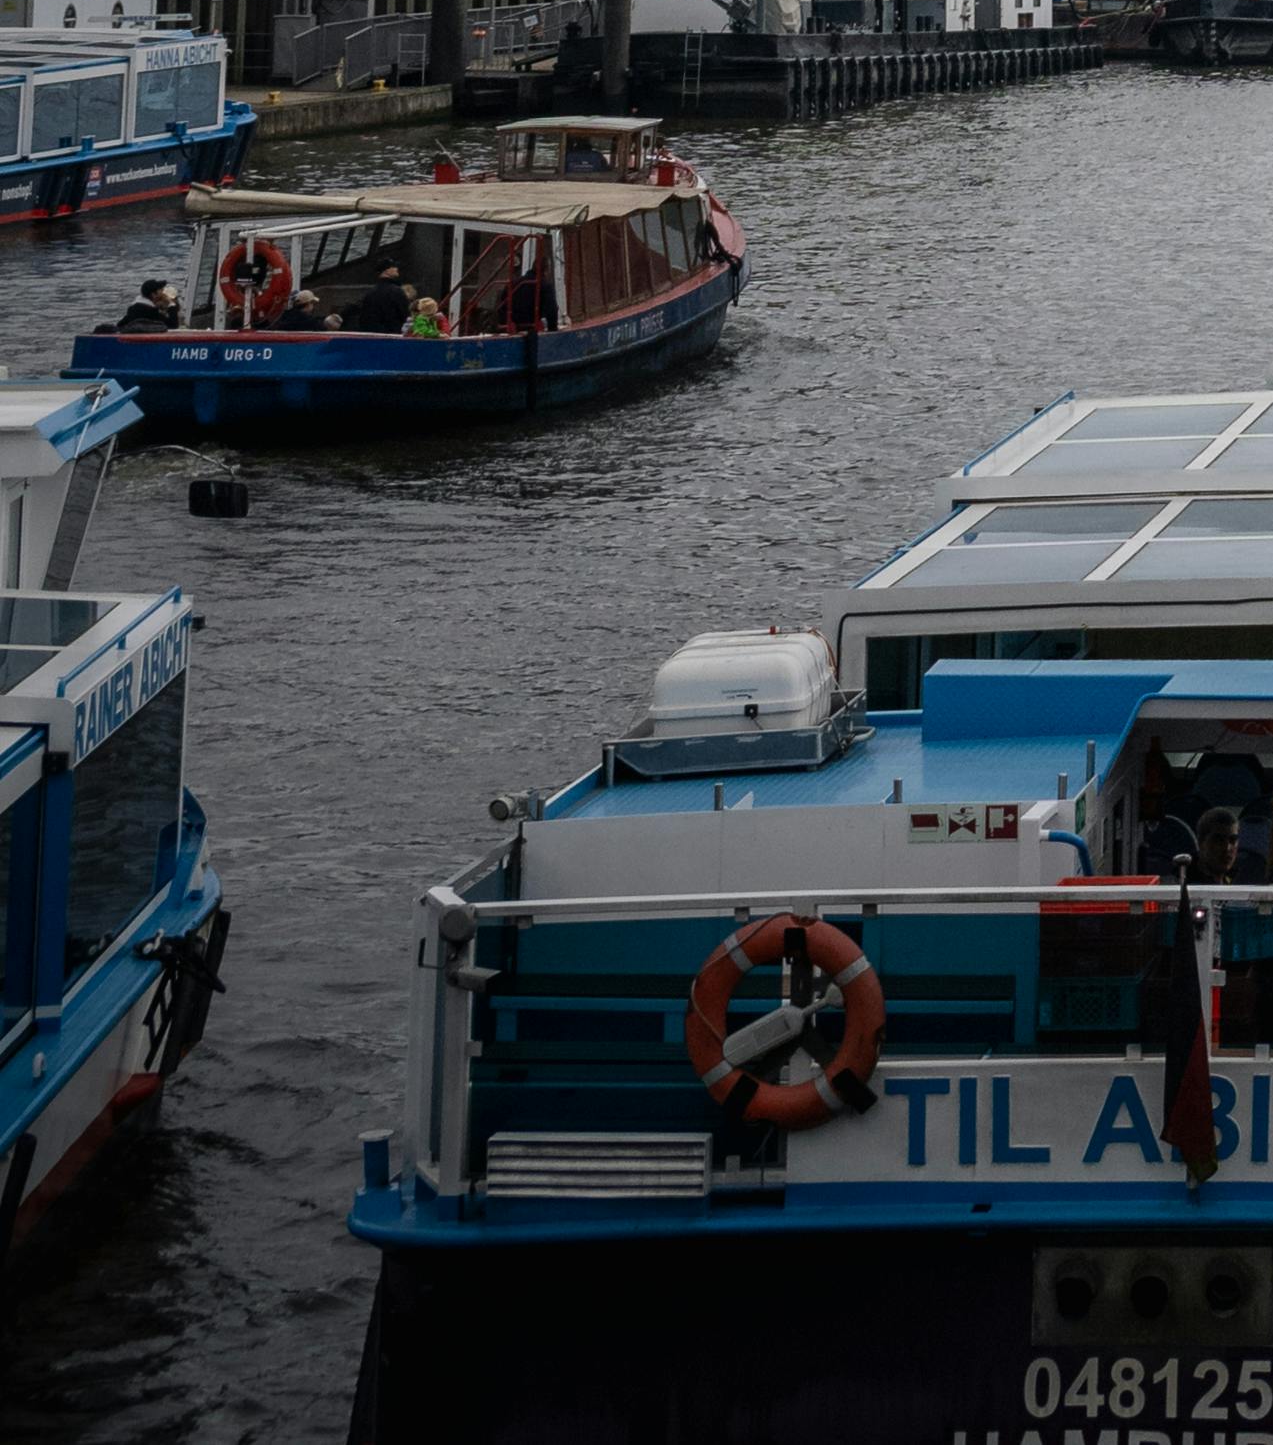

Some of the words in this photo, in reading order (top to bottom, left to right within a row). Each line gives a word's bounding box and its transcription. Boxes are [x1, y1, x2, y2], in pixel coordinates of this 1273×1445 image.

[146, 49, 180, 69] HANNA
[183, 43, 219, 65] ABICHT
[75, 661, 134, 763] RAINER
[139, 610, 192, 708] ABICHT
[884, 1076, 1051, 1167] TIL
